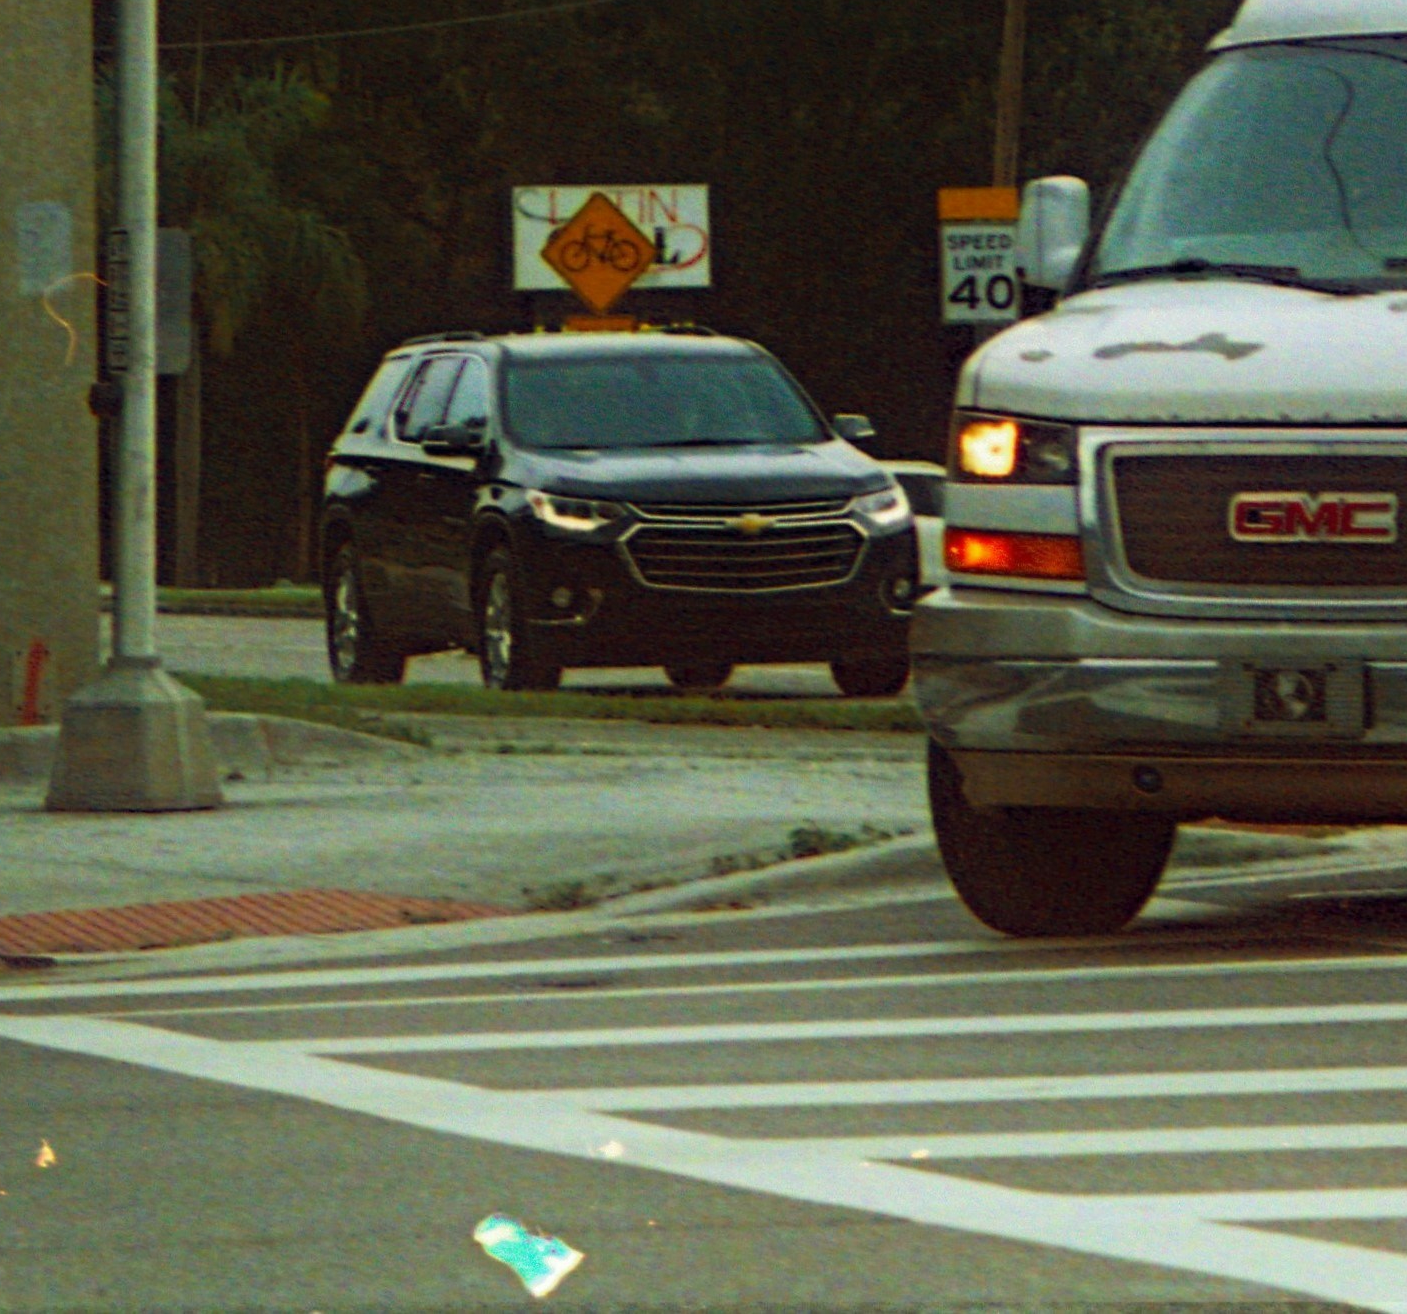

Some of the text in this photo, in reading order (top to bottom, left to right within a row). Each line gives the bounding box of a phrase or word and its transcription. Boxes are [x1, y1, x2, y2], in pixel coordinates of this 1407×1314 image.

[549, 188, 678, 225] LTIN
[946, 233, 1013, 250] SPEED
[952, 254, 1004, 271] LIMIT
[947, 274, 1014, 310] 40
[1231, 495, 1395, 540] GMC
